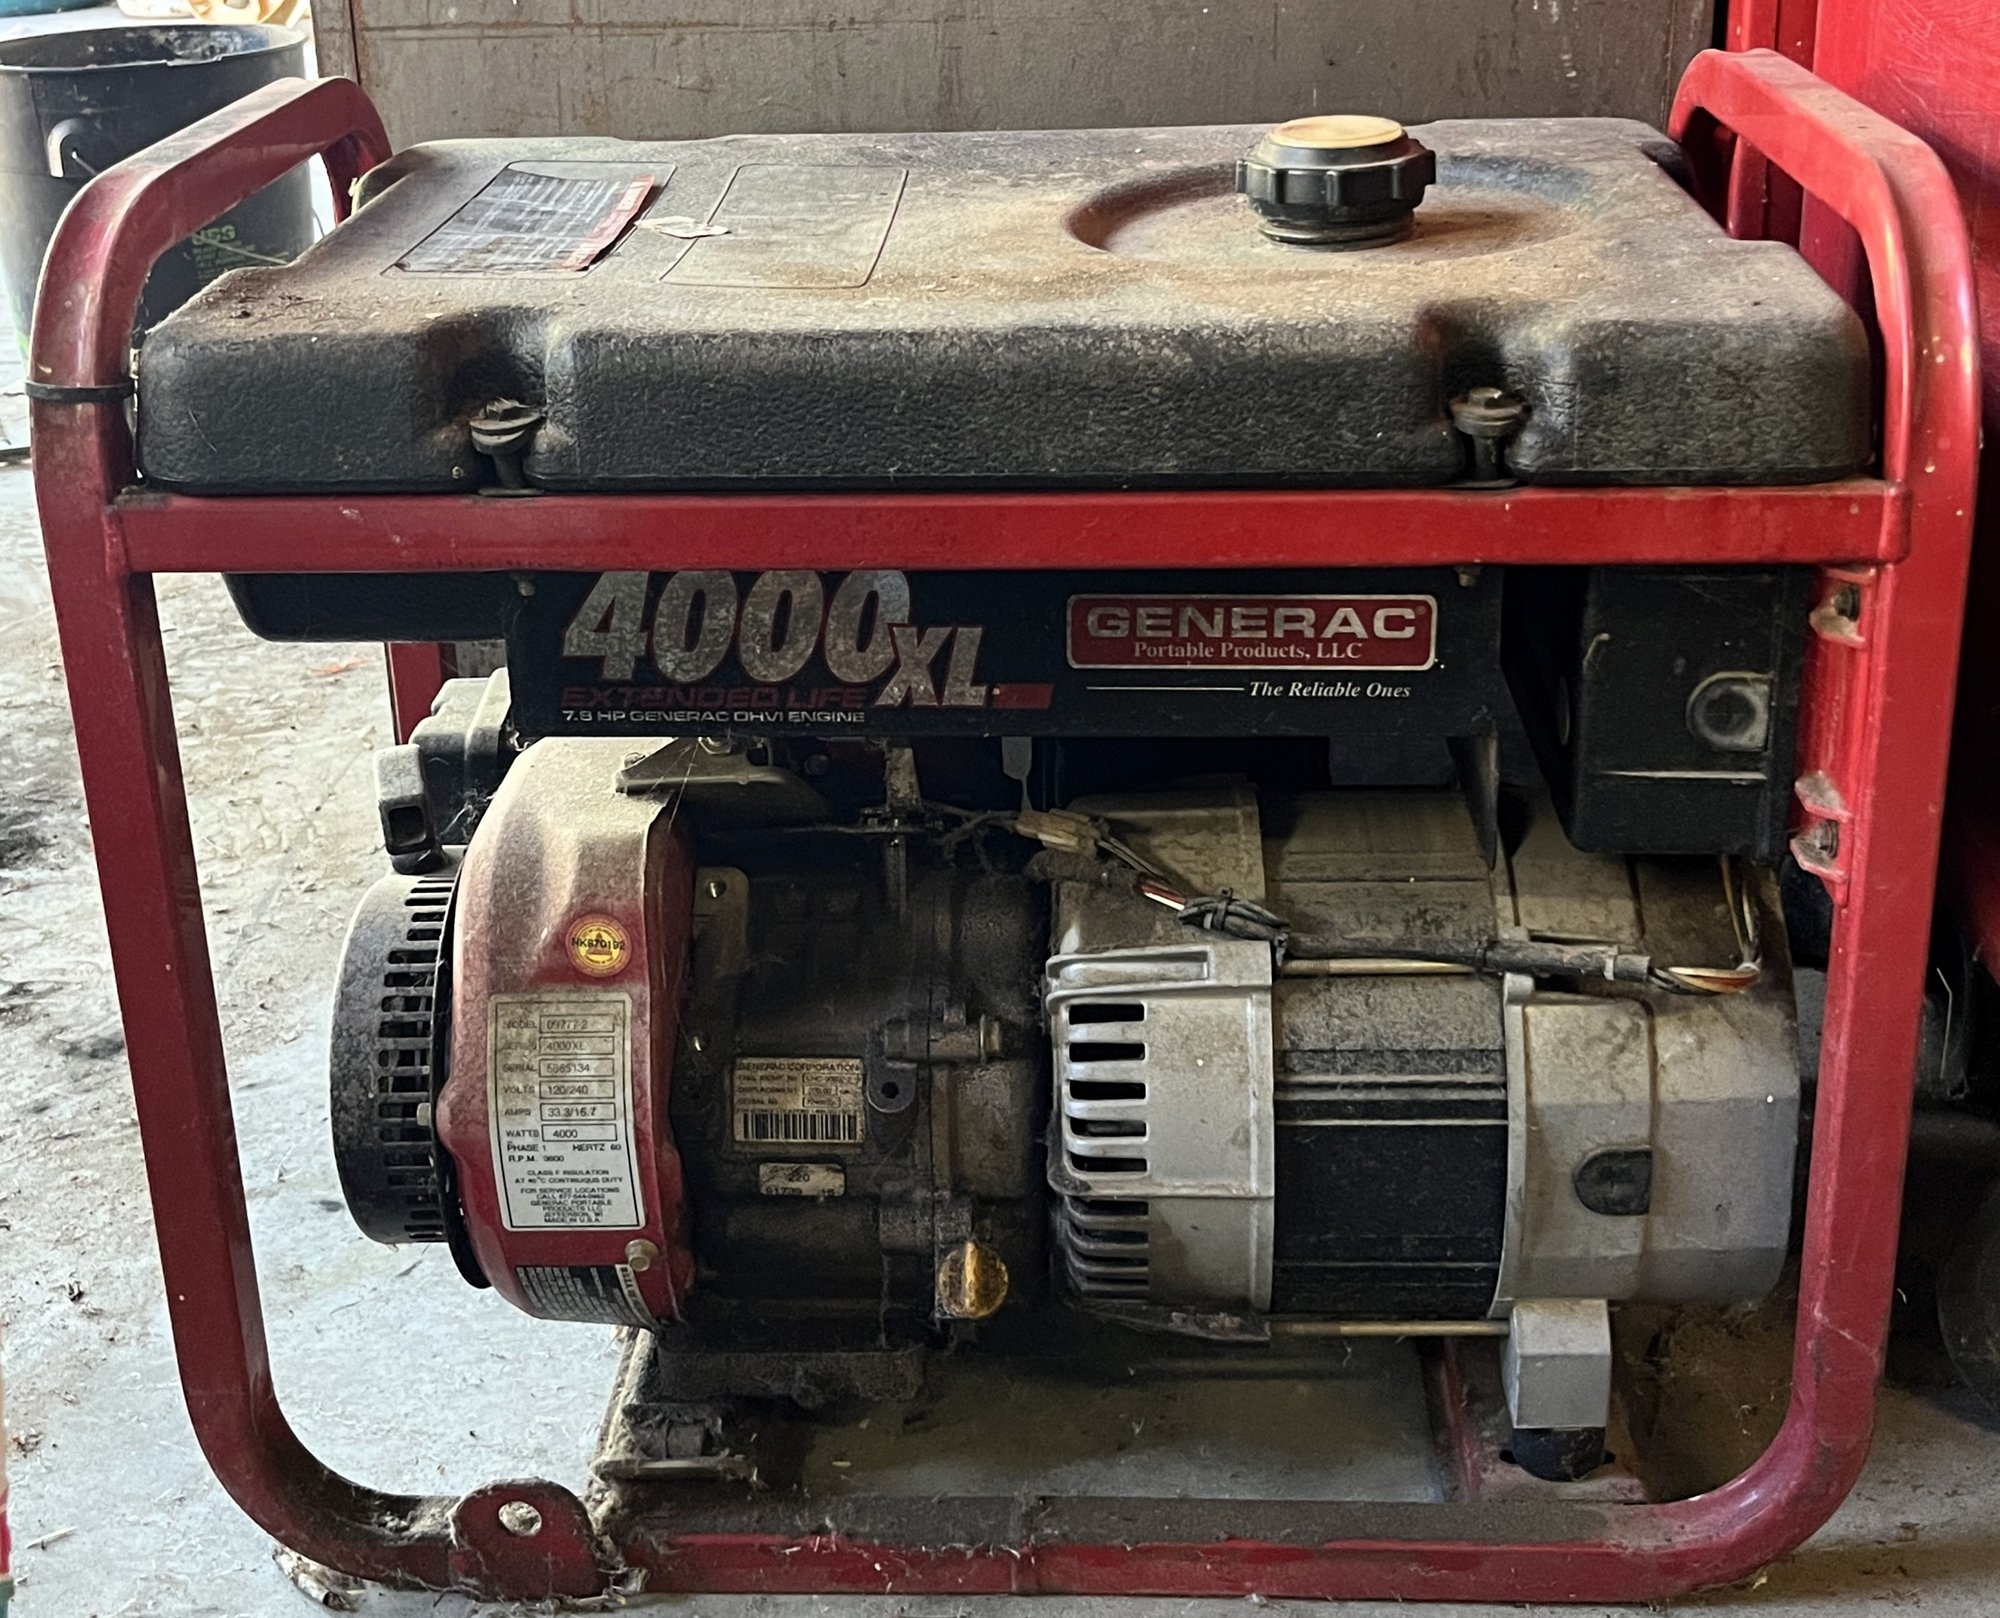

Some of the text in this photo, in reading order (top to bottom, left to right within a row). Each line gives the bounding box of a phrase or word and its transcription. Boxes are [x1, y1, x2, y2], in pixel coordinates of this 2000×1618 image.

[1087, 606, 1416, 640] GENERAC
[562, 570, 987, 707] 4000 XL
[1134, 641, 1363, 661] Portable Products, LLC
[1250, 681, 1411, 698] The Reliable Ones
[562, 686, 867, 708] EXTENDED LIFE
[597, 711, 626, 722] HP
[630, 711, 729, 722] GENERAC
[788, 711, 865, 722] ENGINE
[503, 1085, 589, 1095] VOLTS 120/240
[504, 1108, 531, 1116] AMPS
[505, 1129, 578, 1138] WATTS 4000
[507, 1143, 540, 1151] PHASE
[572, 1143, 606, 1151] HERTZ
[610, 1143, 622, 1151] 60
